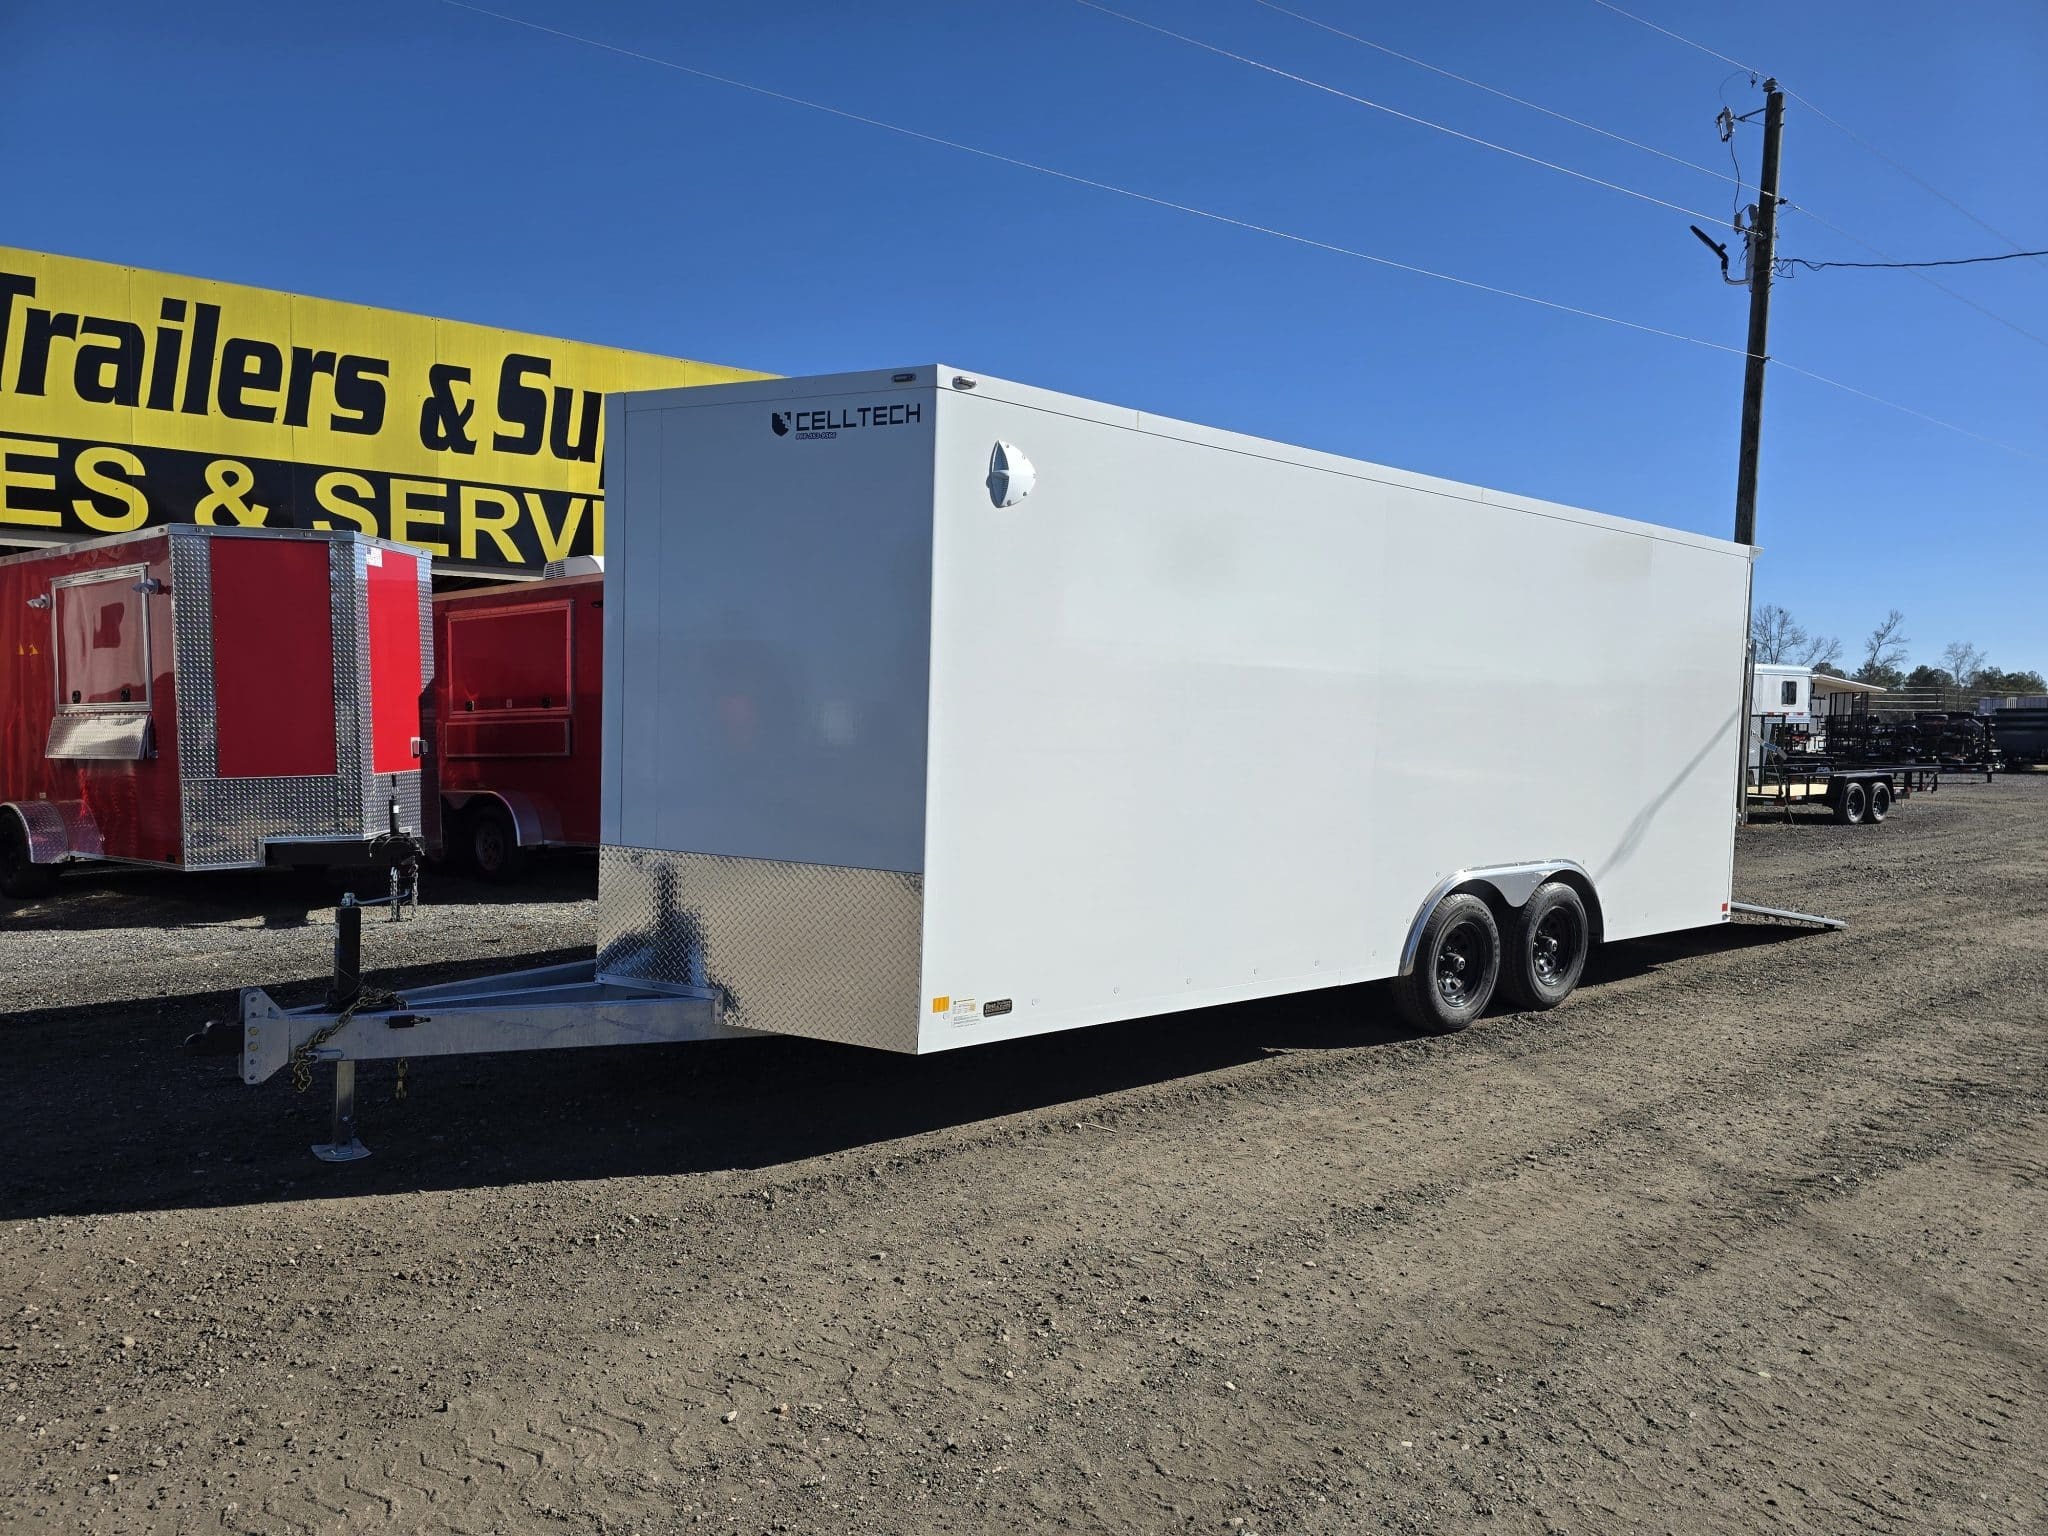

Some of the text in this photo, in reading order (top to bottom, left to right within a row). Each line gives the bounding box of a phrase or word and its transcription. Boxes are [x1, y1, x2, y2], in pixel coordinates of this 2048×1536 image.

[420, 364, 477, 454] &
[493, 352, 604, 489] Su
[796, 403, 921, 431] CELLTECH
[0, 438, 149, 532] ES
[194, 459, 268, 527] &
